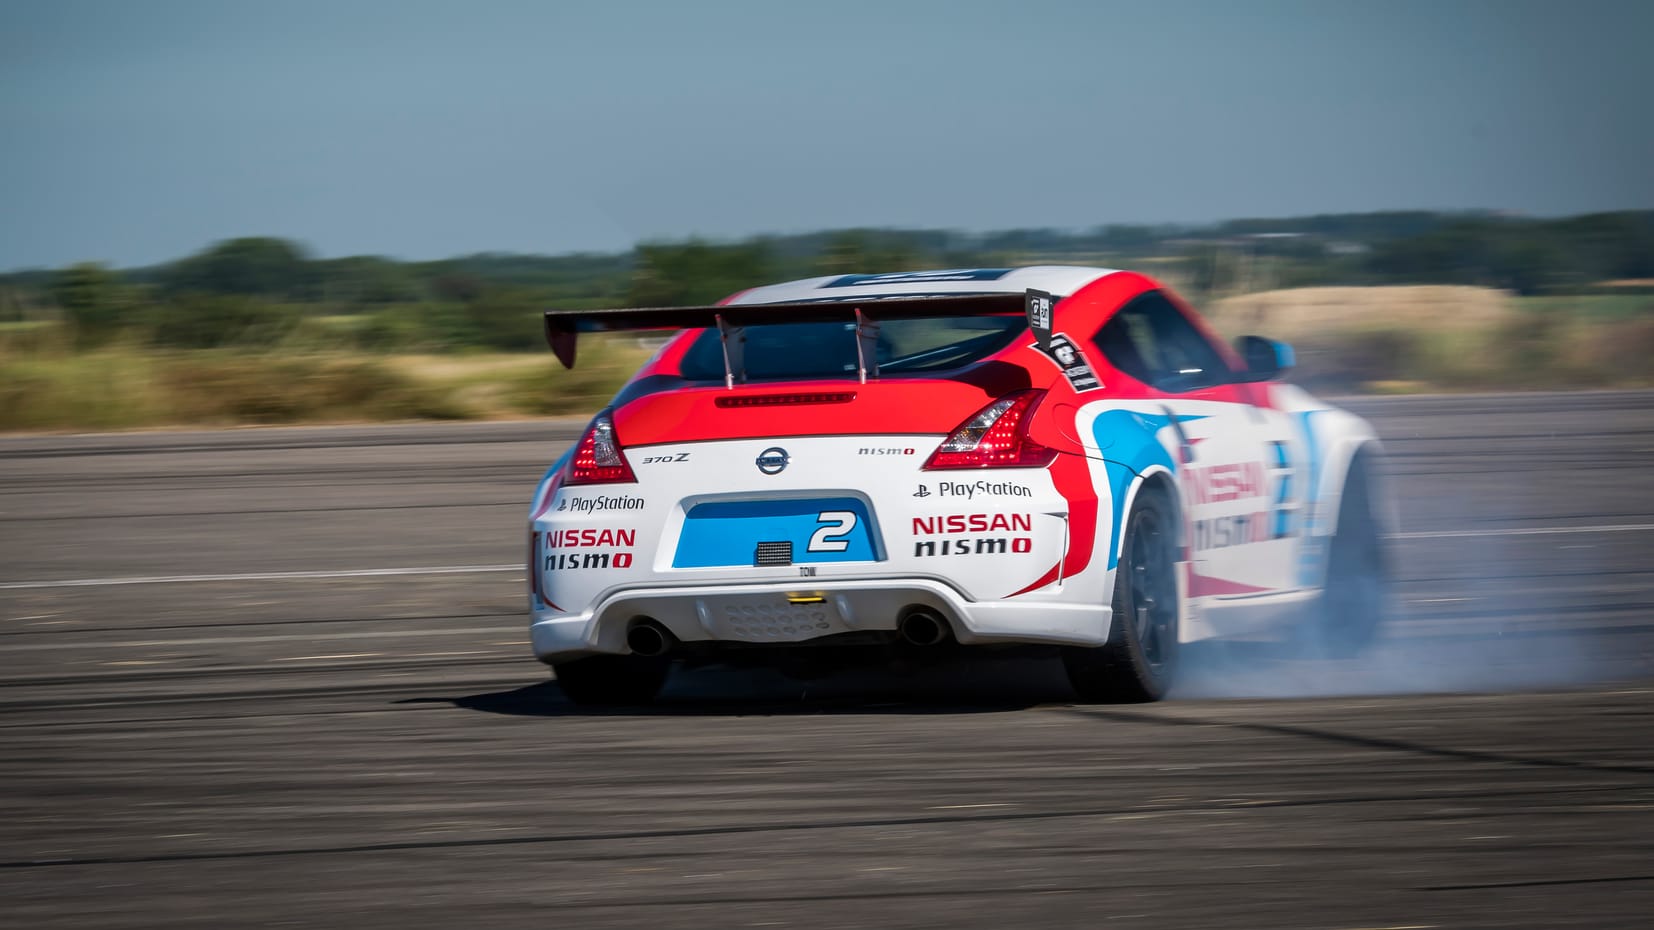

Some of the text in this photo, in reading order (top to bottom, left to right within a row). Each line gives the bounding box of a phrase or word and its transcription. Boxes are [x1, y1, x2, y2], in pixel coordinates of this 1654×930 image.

[642, 452, 691, 464] 370Z
[939, 480, 1032, 500] PlayStation
[570, 495, 645, 515] PlayStation
[807, 511, 857, 553] 2
[912, 513, 1032, 535] NISSAN
[546, 529, 636, 550] NISSAN
[914, 537, 1032, 557] nismo
[545, 553, 633, 571] nismo
